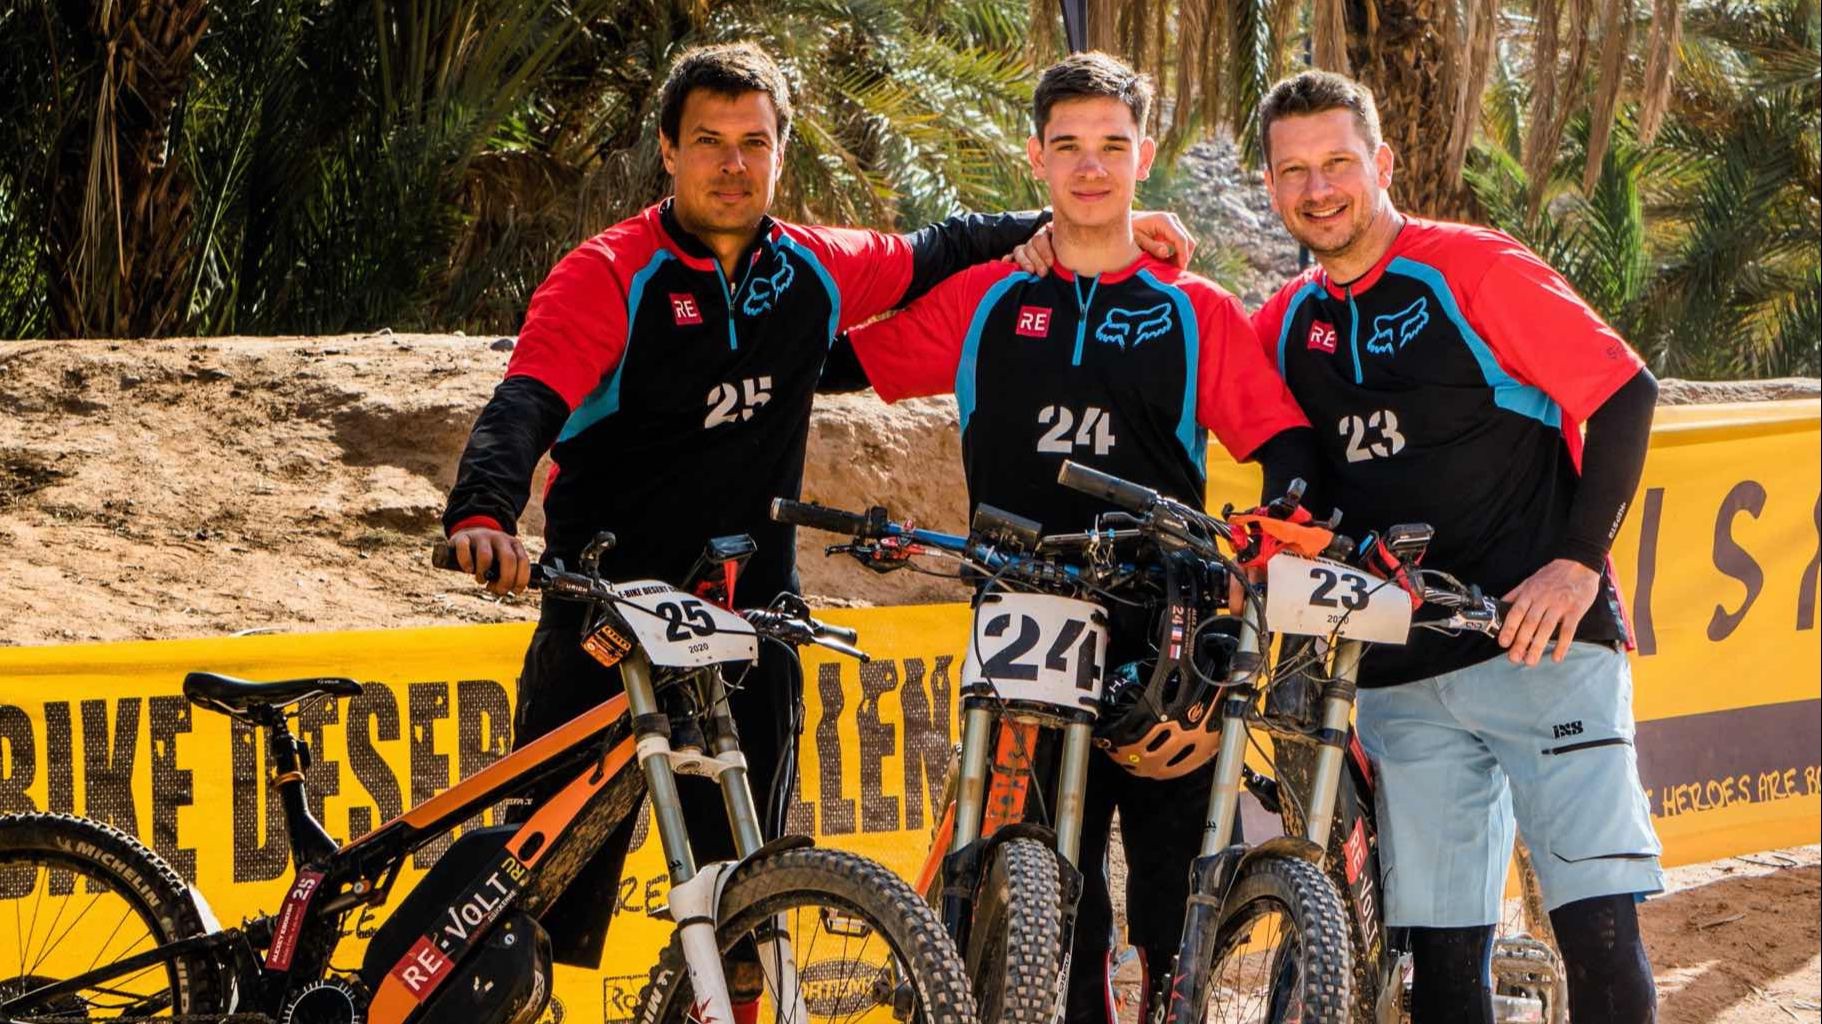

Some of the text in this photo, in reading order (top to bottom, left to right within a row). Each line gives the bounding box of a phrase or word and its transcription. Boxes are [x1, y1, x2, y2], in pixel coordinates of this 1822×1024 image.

[674, 300, 697, 318] RE
[1020, 313, 1047, 331] RE
[1310, 326, 1336, 348] RE
[704, 376, 772, 429] 25
[1037, 405, 1116, 455] 24
[1339, 410, 1406, 463] 23
[1309, 567, 1370, 611] 23
[656, 600, 716, 643] 25
[689, 642, 709, 654] 2020
[980, 613, 1101, 692] 24
[1663, 774, 1751, 817] HEROES
[1758, 768, 1800, 805] ARE
[76, 842, 161, 907] MICHELIN
[292, 878, 316, 901] 25
